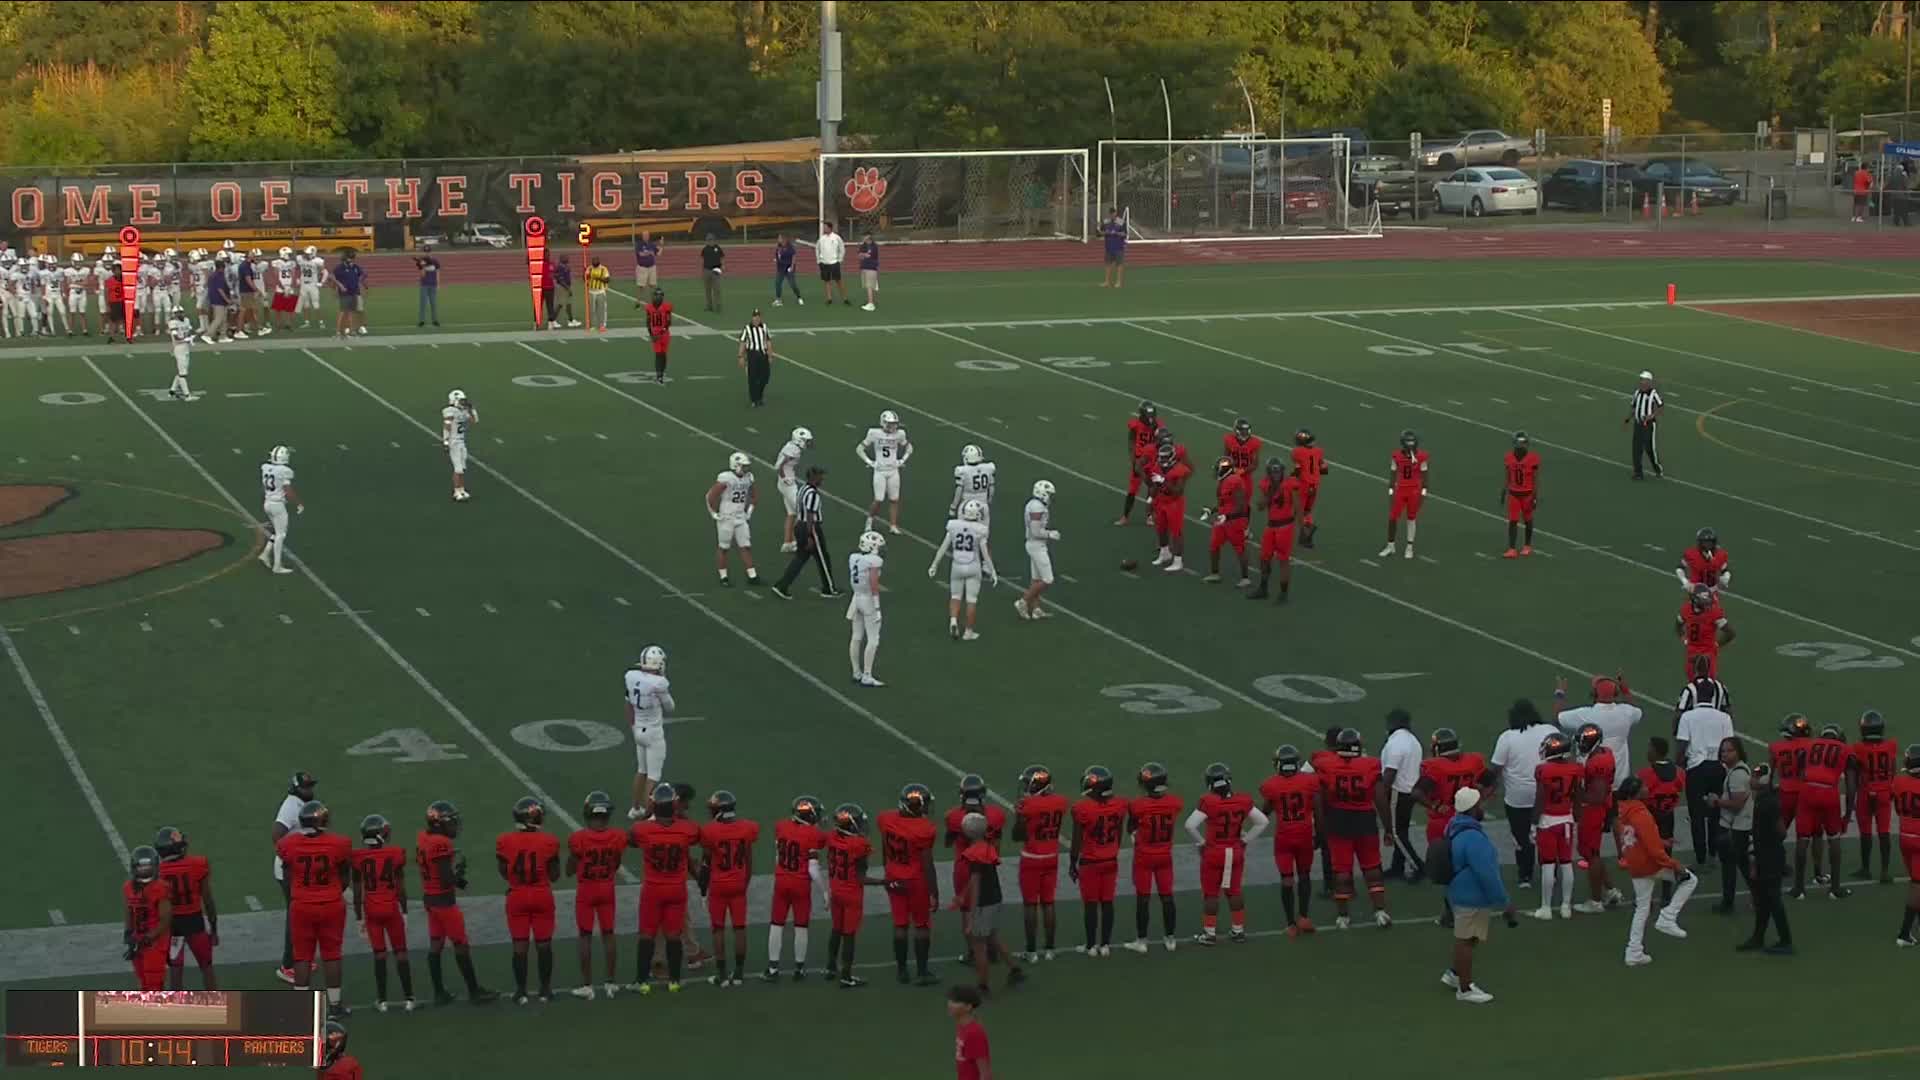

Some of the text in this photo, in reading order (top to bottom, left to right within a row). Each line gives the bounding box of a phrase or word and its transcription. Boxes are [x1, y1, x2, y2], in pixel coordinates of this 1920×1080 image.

[11, 169, 764, 229] OME OF THE TIGERS
[578, 223, 592, 244] 2
[882, 446, 891, 458] 5
[972, 473, 989, 490] 50
[731, 491, 747, 503] 22
[955, 533, 975, 552] 23
[1279, 792, 1306, 822] 12
[297, 855, 330, 886] 72
[512, 850, 538, 884] 41
